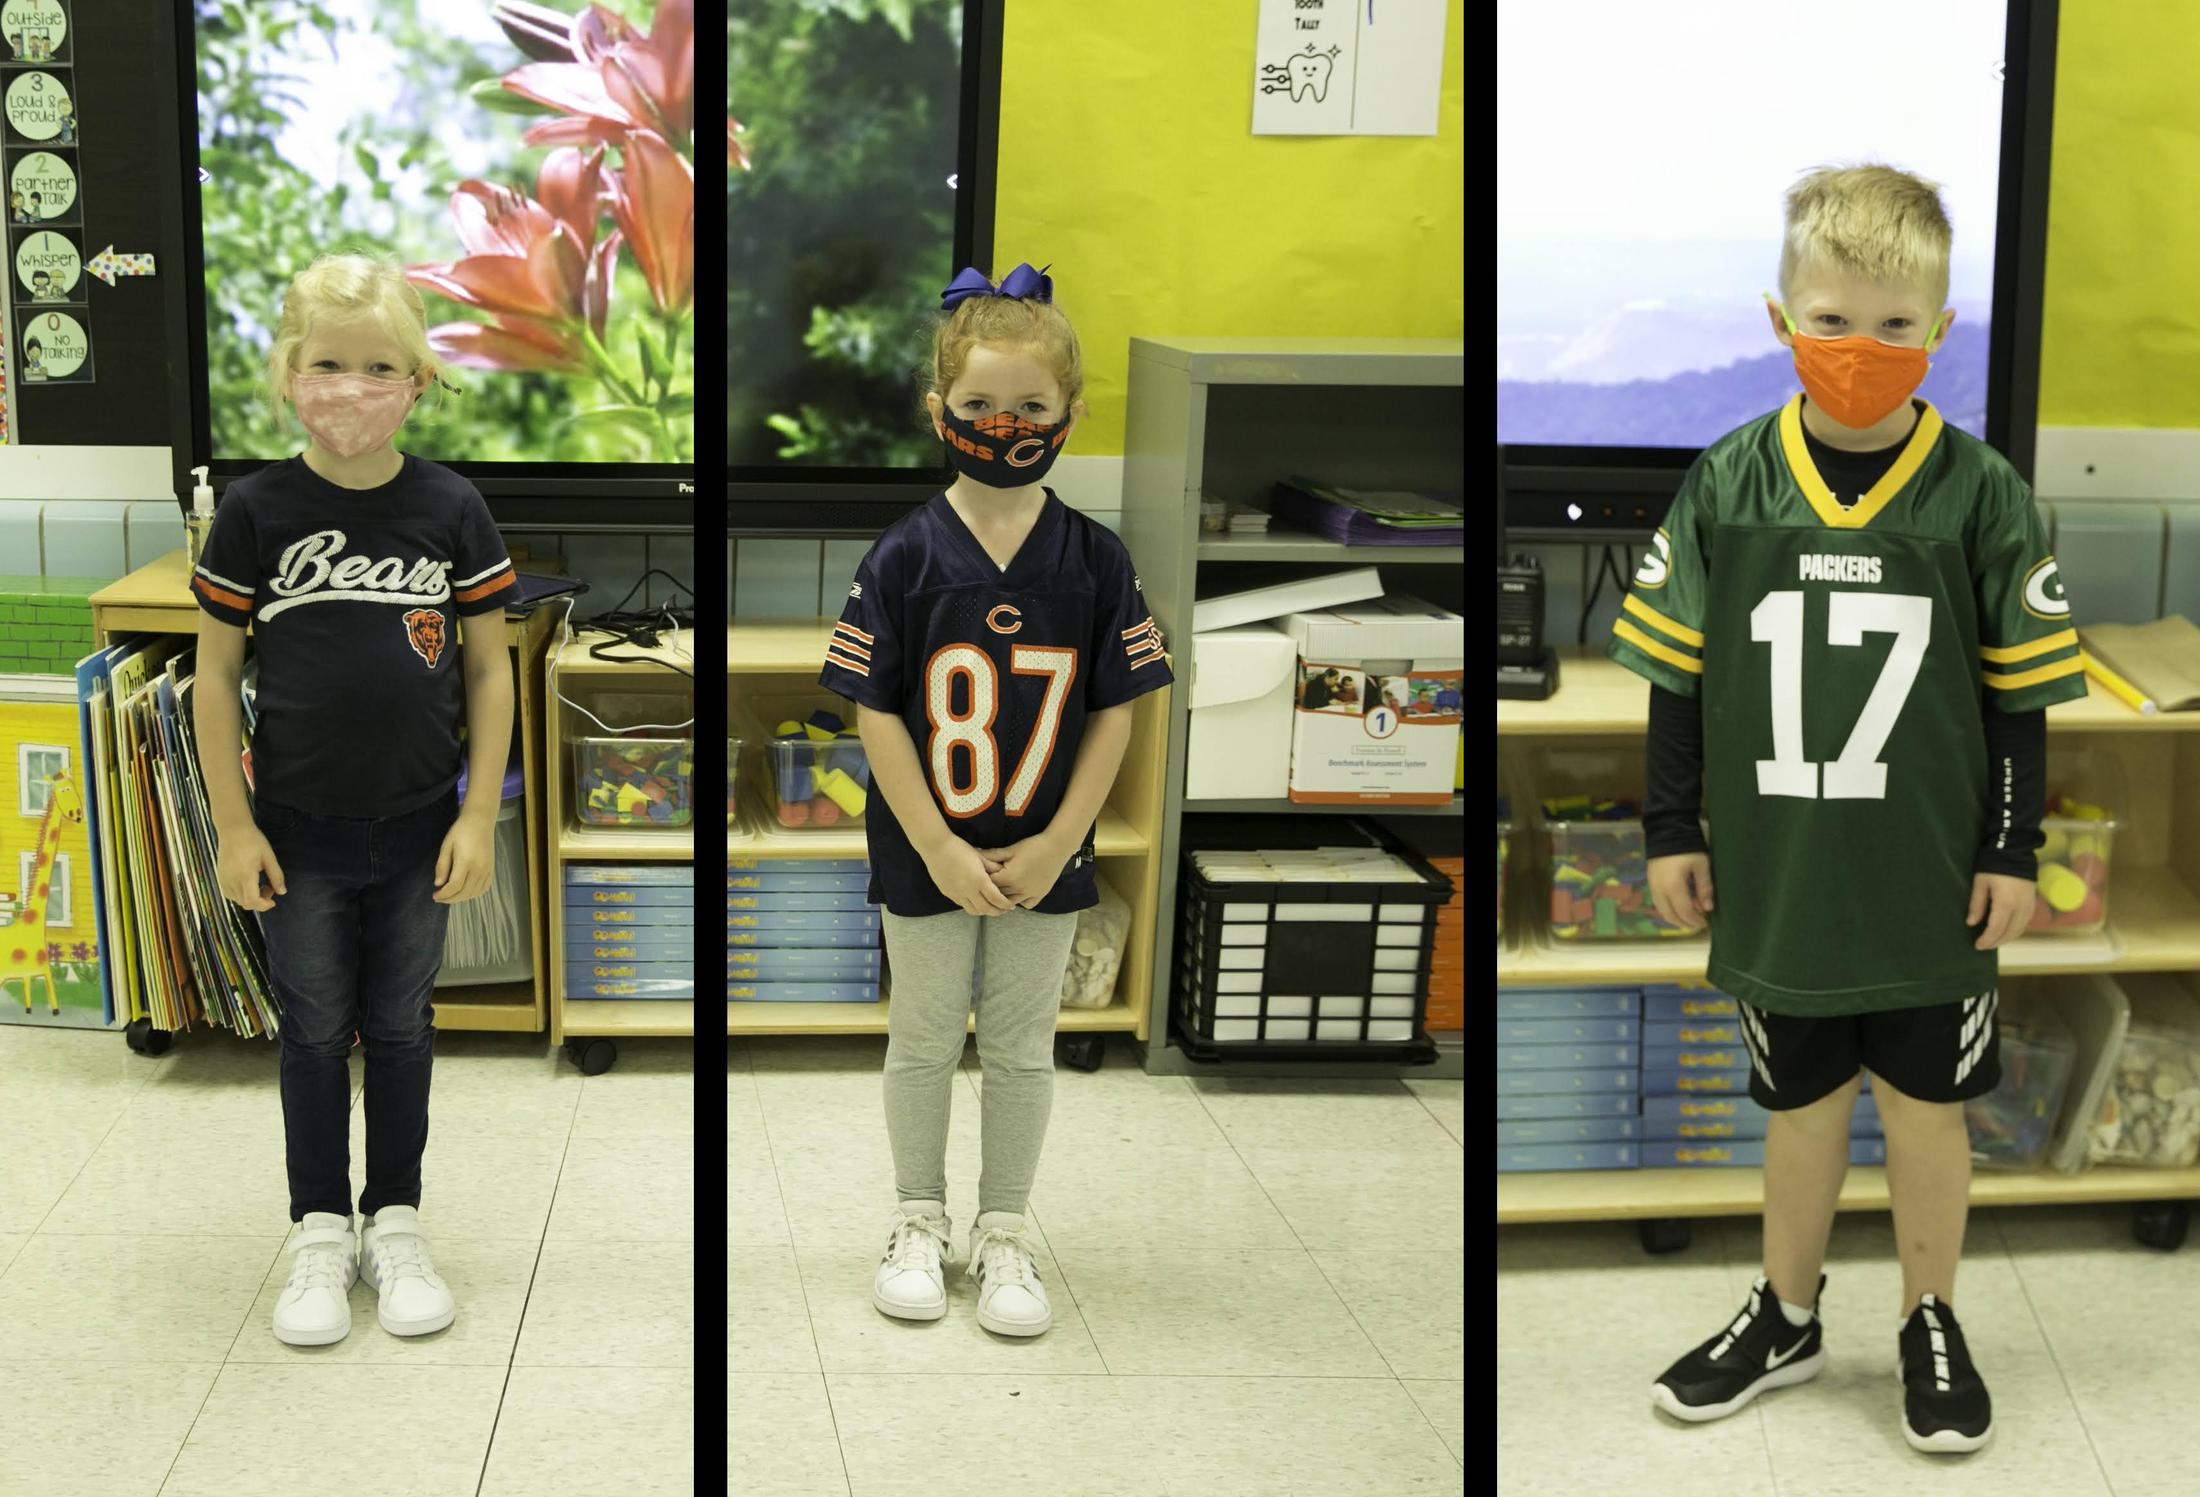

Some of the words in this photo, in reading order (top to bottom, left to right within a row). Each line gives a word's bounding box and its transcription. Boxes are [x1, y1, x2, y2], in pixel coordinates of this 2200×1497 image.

[31, 73, 43, 92] 3
[10, 95, 43, 108] Loud
[48, 95, 57, 108] &
[35, 154, 49, 173] 2
[41, 192, 68, 206] Talk
[19, 253, 77, 268] Whisper
[42, 347, 85, 360] Talking
[1004, 438, 1044, 467] C
[268, 529, 453, 606] Bears
[1799, 553, 1882, 583] PACKERS
[986, 604, 1023, 634] C
[1750, 590, 1933, 799] 17
[925, 643, 1077, 819] 87
[1375, 712, 1387, 732] 1
[2003, 757, 2012, 803] UNDER
